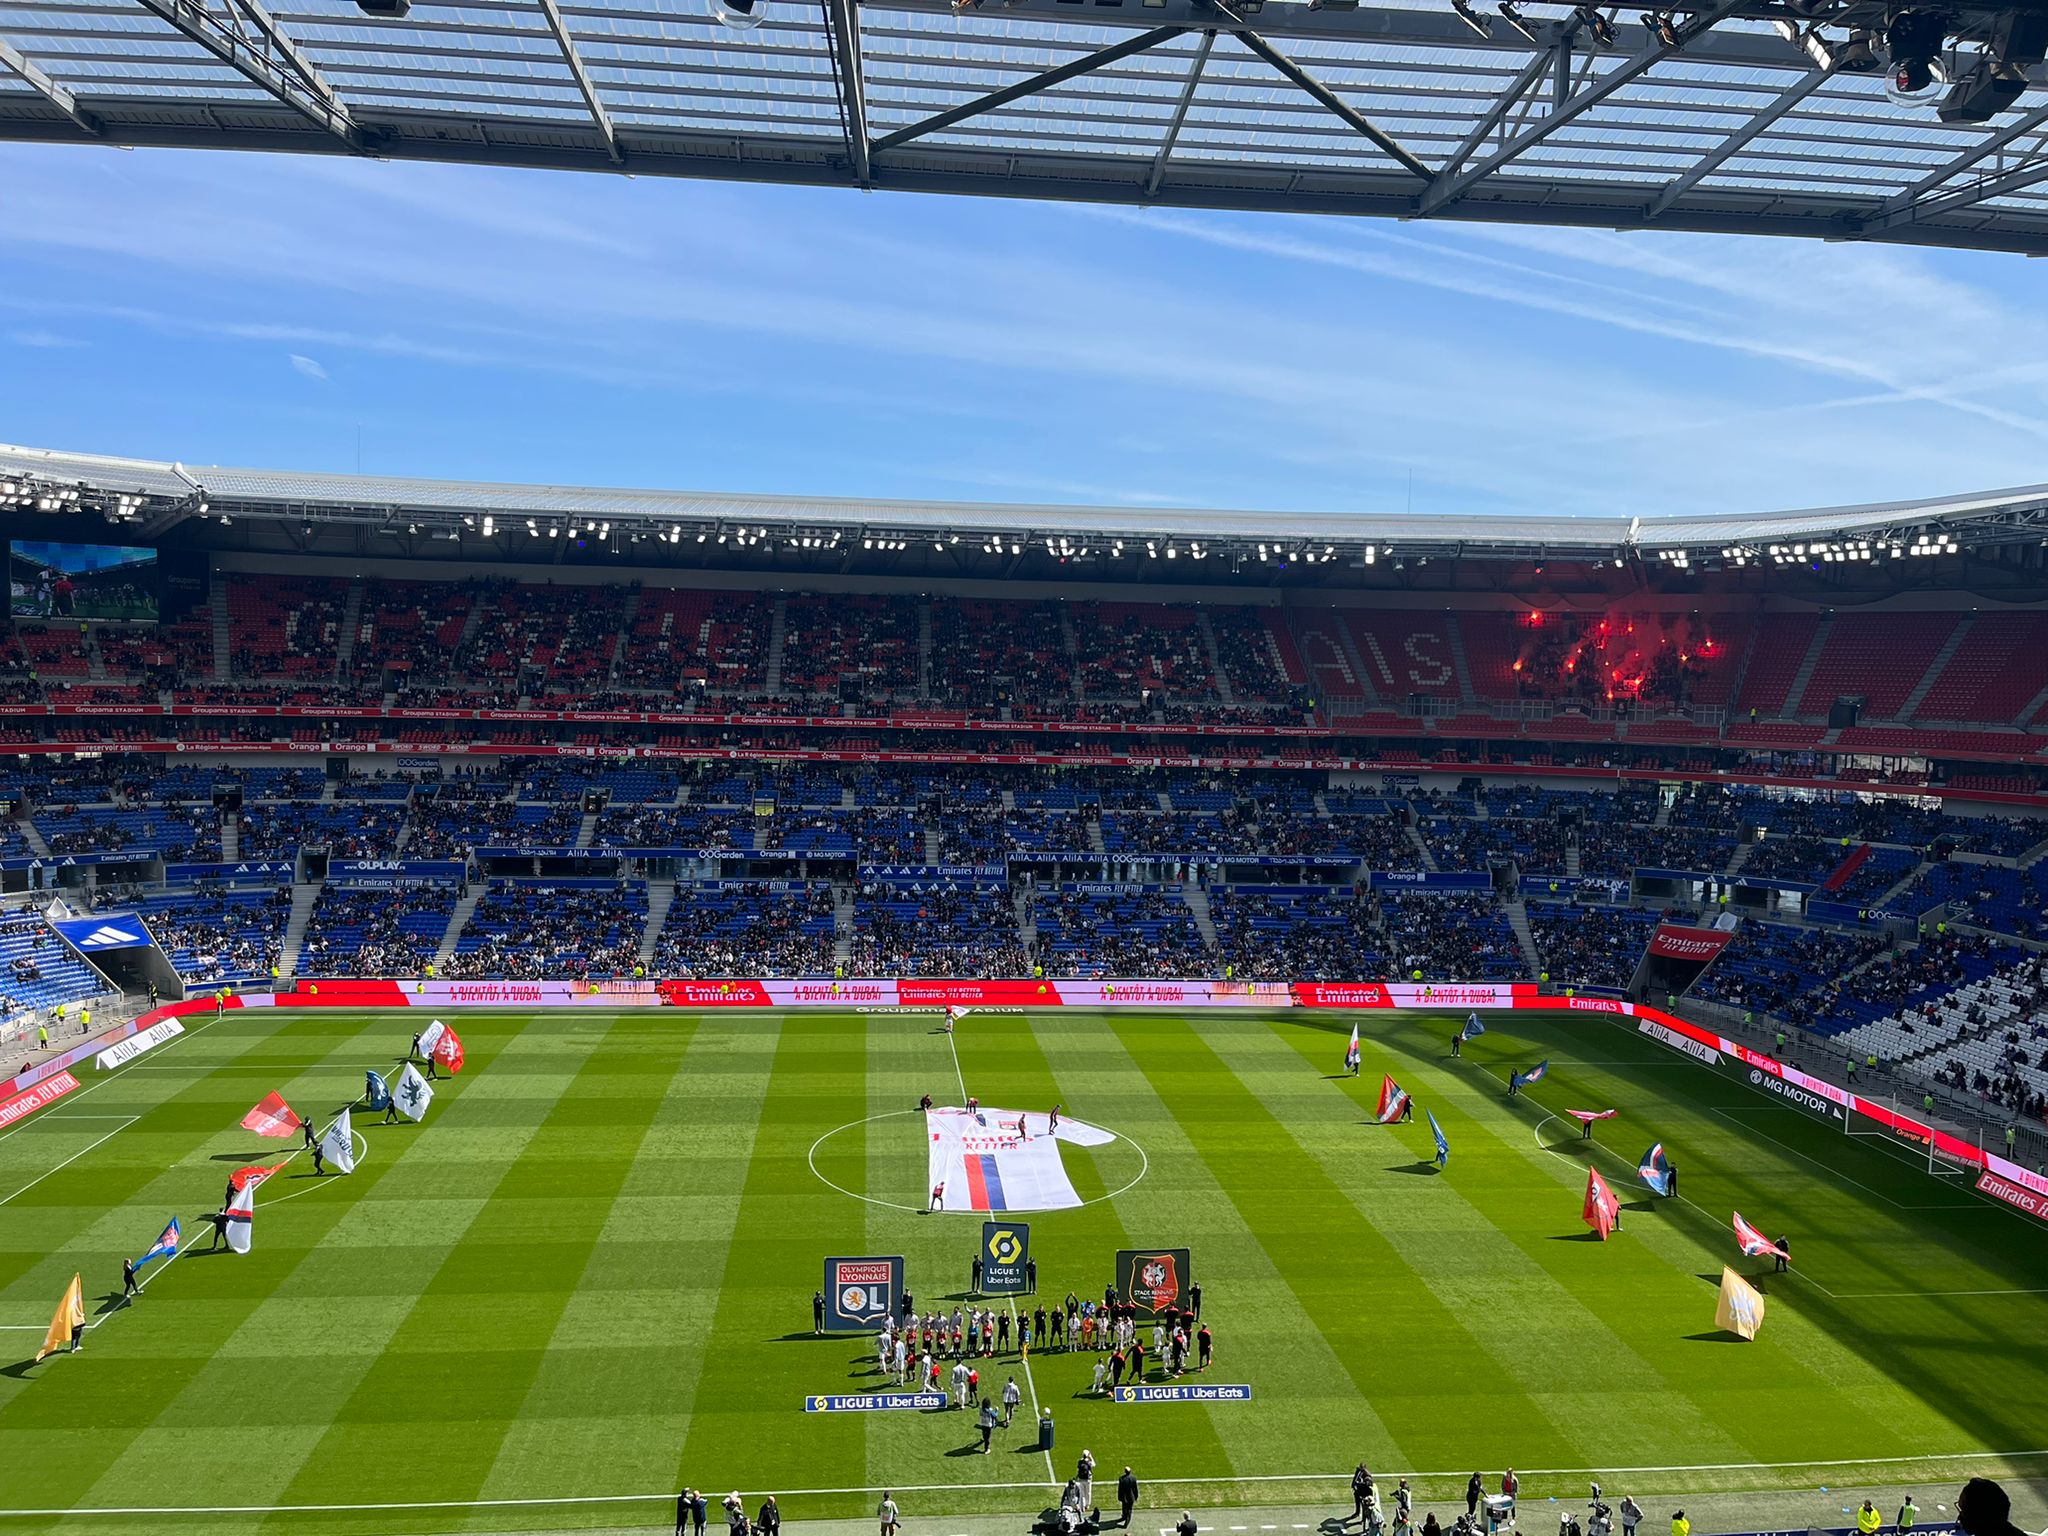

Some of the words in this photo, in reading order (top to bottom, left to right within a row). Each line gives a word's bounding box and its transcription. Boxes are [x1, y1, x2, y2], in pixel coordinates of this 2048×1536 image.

[75, 706, 114, 714] Groupama
[301, 708, 335, 716] Groupama
[573, 713, 605, 721] Groupama
[658, 715, 690, 723] Groupama
[741, 717, 772, 725] Groupama
[823, 718, 853, 726] Groupama
[902, 720, 932, 728] Groupama
[981, 722, 1010, 730] Groupama
[1136, 725, 1165, 733] Groupama
[1213, 727, 1242, 735] Groupama
[1280, 728, 1307, 736] Groupama
[289, 743, 320, 752] Orange
[335, 743, 366, 752] Orange
[557, 747, 586, 756] Orange
[599, 748, 627, 756] Orange
[1127, 757, 1153, 766] Orange
[1165, 759, 1191, 767] Orange
[1278, 760, 1304, 769] Orange
[1316, 761, 1342, 769] Orange
[699, 850, 744, 859] OOGarden
[759, 850, 787, 859] Orange
[1112, 855, 1155, 863] OOGarden
[937, 866, 973, 875] Emirates
[1387, 872, 1416, 882] Orange
[358, 879, 393, 887] Emirates
[1076, 883, 1113, 893] Emirates
[1657, 934, 1722, 948] Emirates
[510, 986, 542, 1001] DUBAI
[852, 986, 882, 1000] DUBAI
[1155, 986, 1184, 1000] DUBAI
[1315, 987, 1380, 1003] Emirates
[1569, 998, 1618, 1011] Emirates
[855, 1006, 947, 1014] Groupama
[1747, 1050, 1779, 1074] Emirates
[36, 1085, 53, 1101] FLY
[1763, 1077, 1783, 1093] MG
[1783, 1085, 1827, 1113] MOTOR
[1896, 1128, 1921, 1141] Orange
[1980, 1175, 2037, 1210] Emirates
[2037, 1202, 2048, 1217] FL
[841, 1265, 888, 1273] OLYMPIQUE
[989, 1267, 1014, 1275] LIGUE
[841, 1273, 888, 1281] LYONNAIS
[987, 1276, 1004, 1284] Uber
[1004, 1276, 1022, 1284] Eats
[1142, 1388, 1180, 1400] LIGUE
[1182, 1387, 1188, 1399] 1
[1192, 1387, 1217, 1399] Uber
[1217, 1386, 1244, 1399] Eats
[834, 1397, 874, 1409] LIGUE
[876, 1397, 883, 1408] 1
[886, 1396, 913, 1408] Uber
[913, 1395, 940, 1407] Eats
